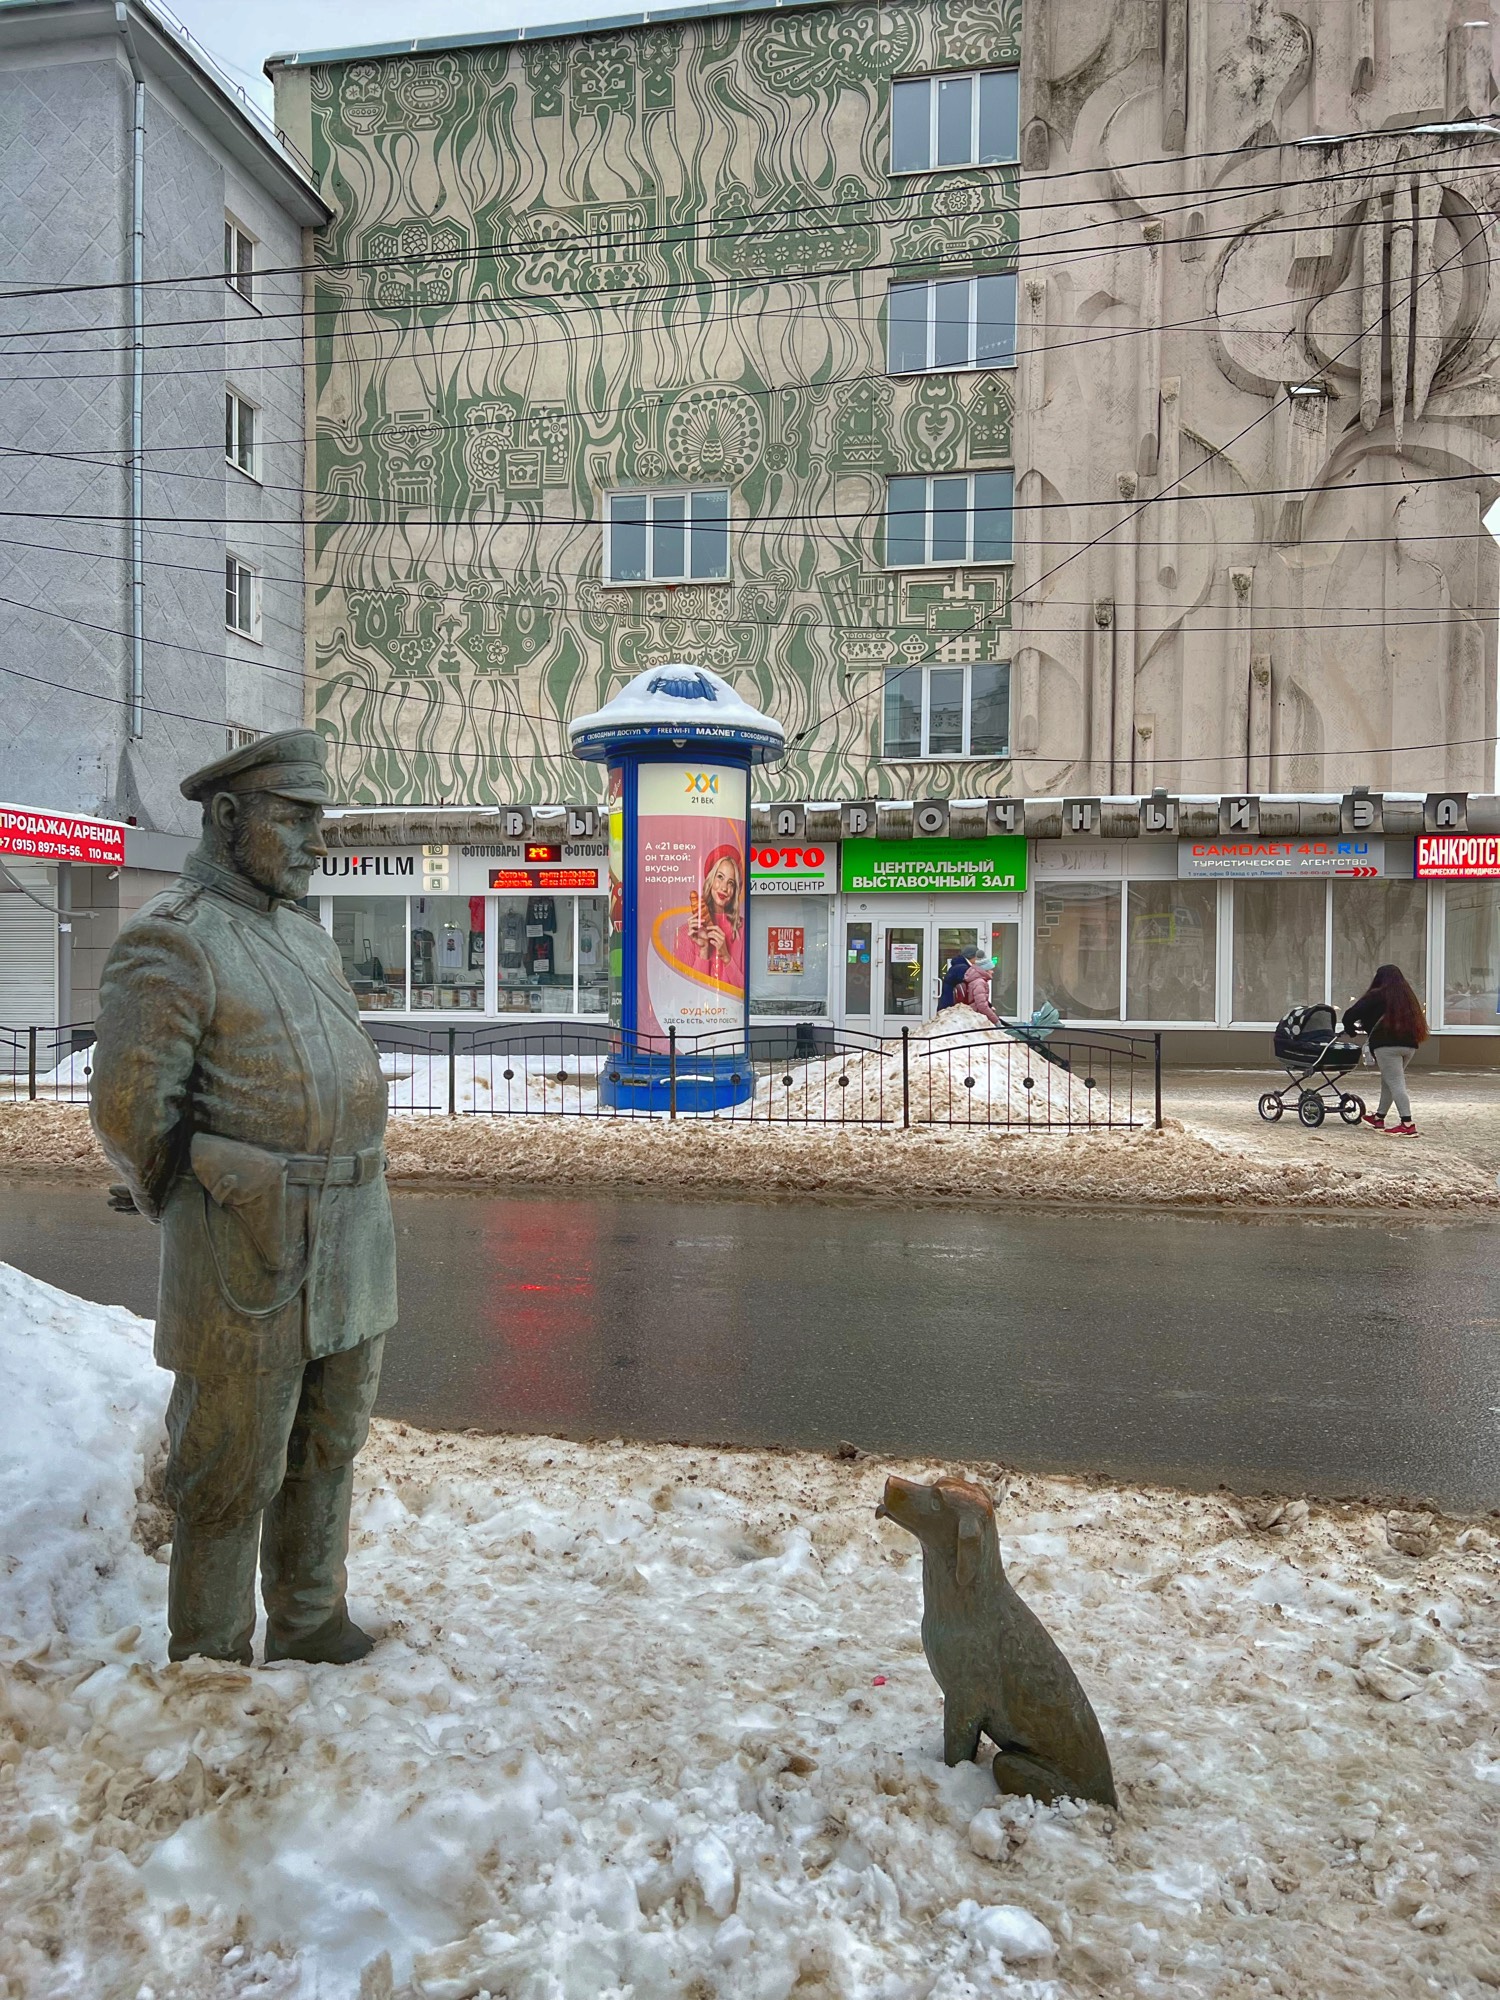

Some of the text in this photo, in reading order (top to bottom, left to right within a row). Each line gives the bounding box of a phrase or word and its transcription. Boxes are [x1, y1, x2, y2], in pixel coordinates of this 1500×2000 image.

[696, 728, 735, 737] MAXNET
[0, 813, 122, 845] ПРОДАЖА/АРЕНДА
[12, 838, 36, 853] (915)
[38, 841, 82, 857] 897-15-56.
[89, 847, 101, 859] 110
[645, 842, 652, 850] А
[655, 842, 670, 850] «21
[462, 845, 520, 857] ФОТОТОВАРЫ
[660, 853, 691, 861] такой:
[873, 859, 994, 875] ЦЕНТРАЛЬНЫЙ
[1193, 859, 1368, 867] ТУРИСТИЧЕСКОЕ АГЕНТСТВО
[645, 875, 695, 884] накормит!
[852, 874, 1015, 888] ВЫСТАВОЧНЫЙ ЗАЛ
[760, 881, 825, 892] ФОТОЦЕНТР
[777, 940, 793, 948] 651
[680, 1007, 728, 1016] ФУД-КОРТ:
